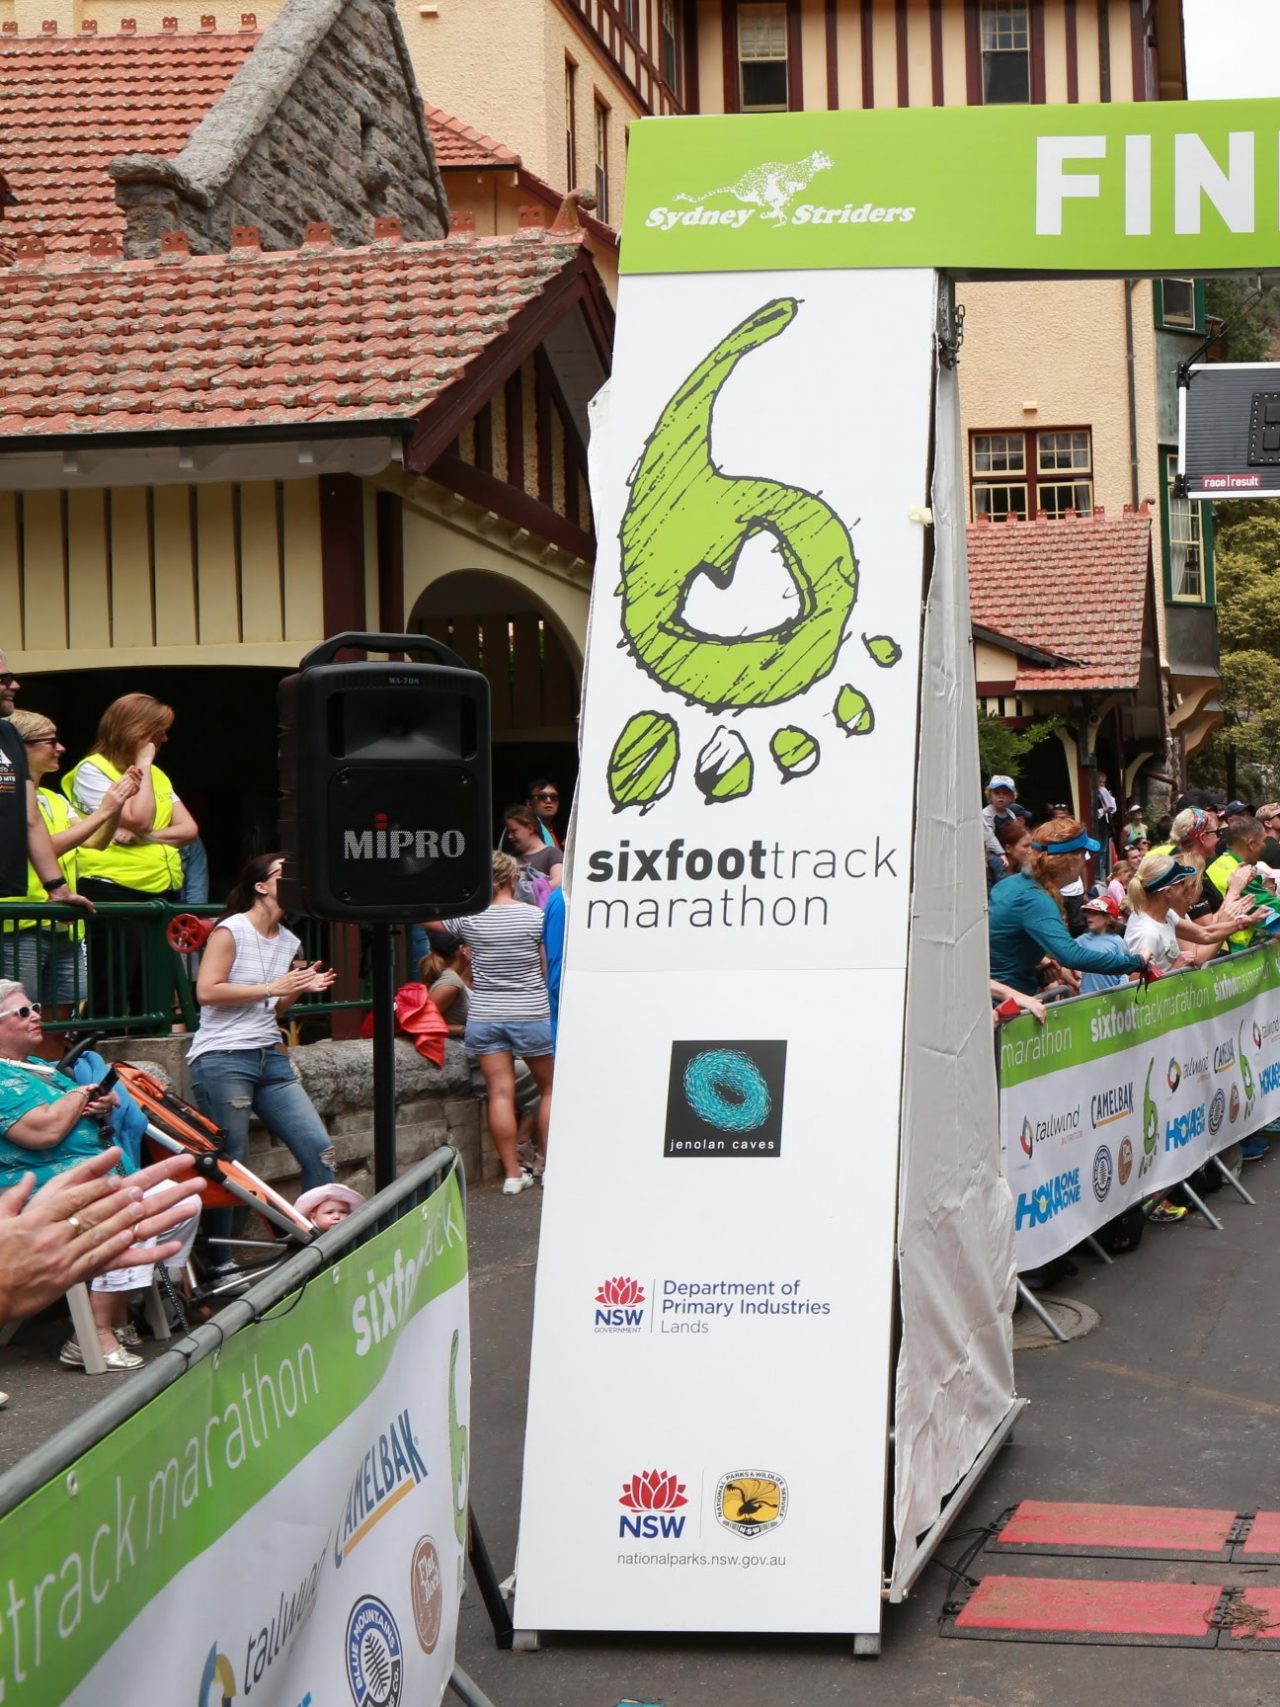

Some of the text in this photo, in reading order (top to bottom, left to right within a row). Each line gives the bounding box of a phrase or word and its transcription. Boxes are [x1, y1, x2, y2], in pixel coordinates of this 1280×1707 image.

[645, 203, 915, 230] Sydney Striders
[587, 884, 828, 929] marathon
[1001, 1024, 1072, 1069] marathon
[1035, 1082, 1134, 1142] tailwind CAMELBAK
[669, 1139, 775, 1153] jenolan caves
[1015, 1172, 1065, 1231] HOKA
[664, 1280, 801, 1298] Department of
[594, 1309, 644, 1326] NSW
[661, 1299, 831, 1317] Primary Industries
[661, 1320, 709, 1334] Lands
[725, 1471, 749, 1480] PARKS
[335, 1409, 428, 1568] CAMELBAK
[619, 1515, 686, 1538] NSW
[740, 1526, 760, 1535] NSW
[617, 1552, 786, 1569] nationalparks.nsw.gov.au
[352, 1608, 395, 1690] BLUE MOUNTAINS
